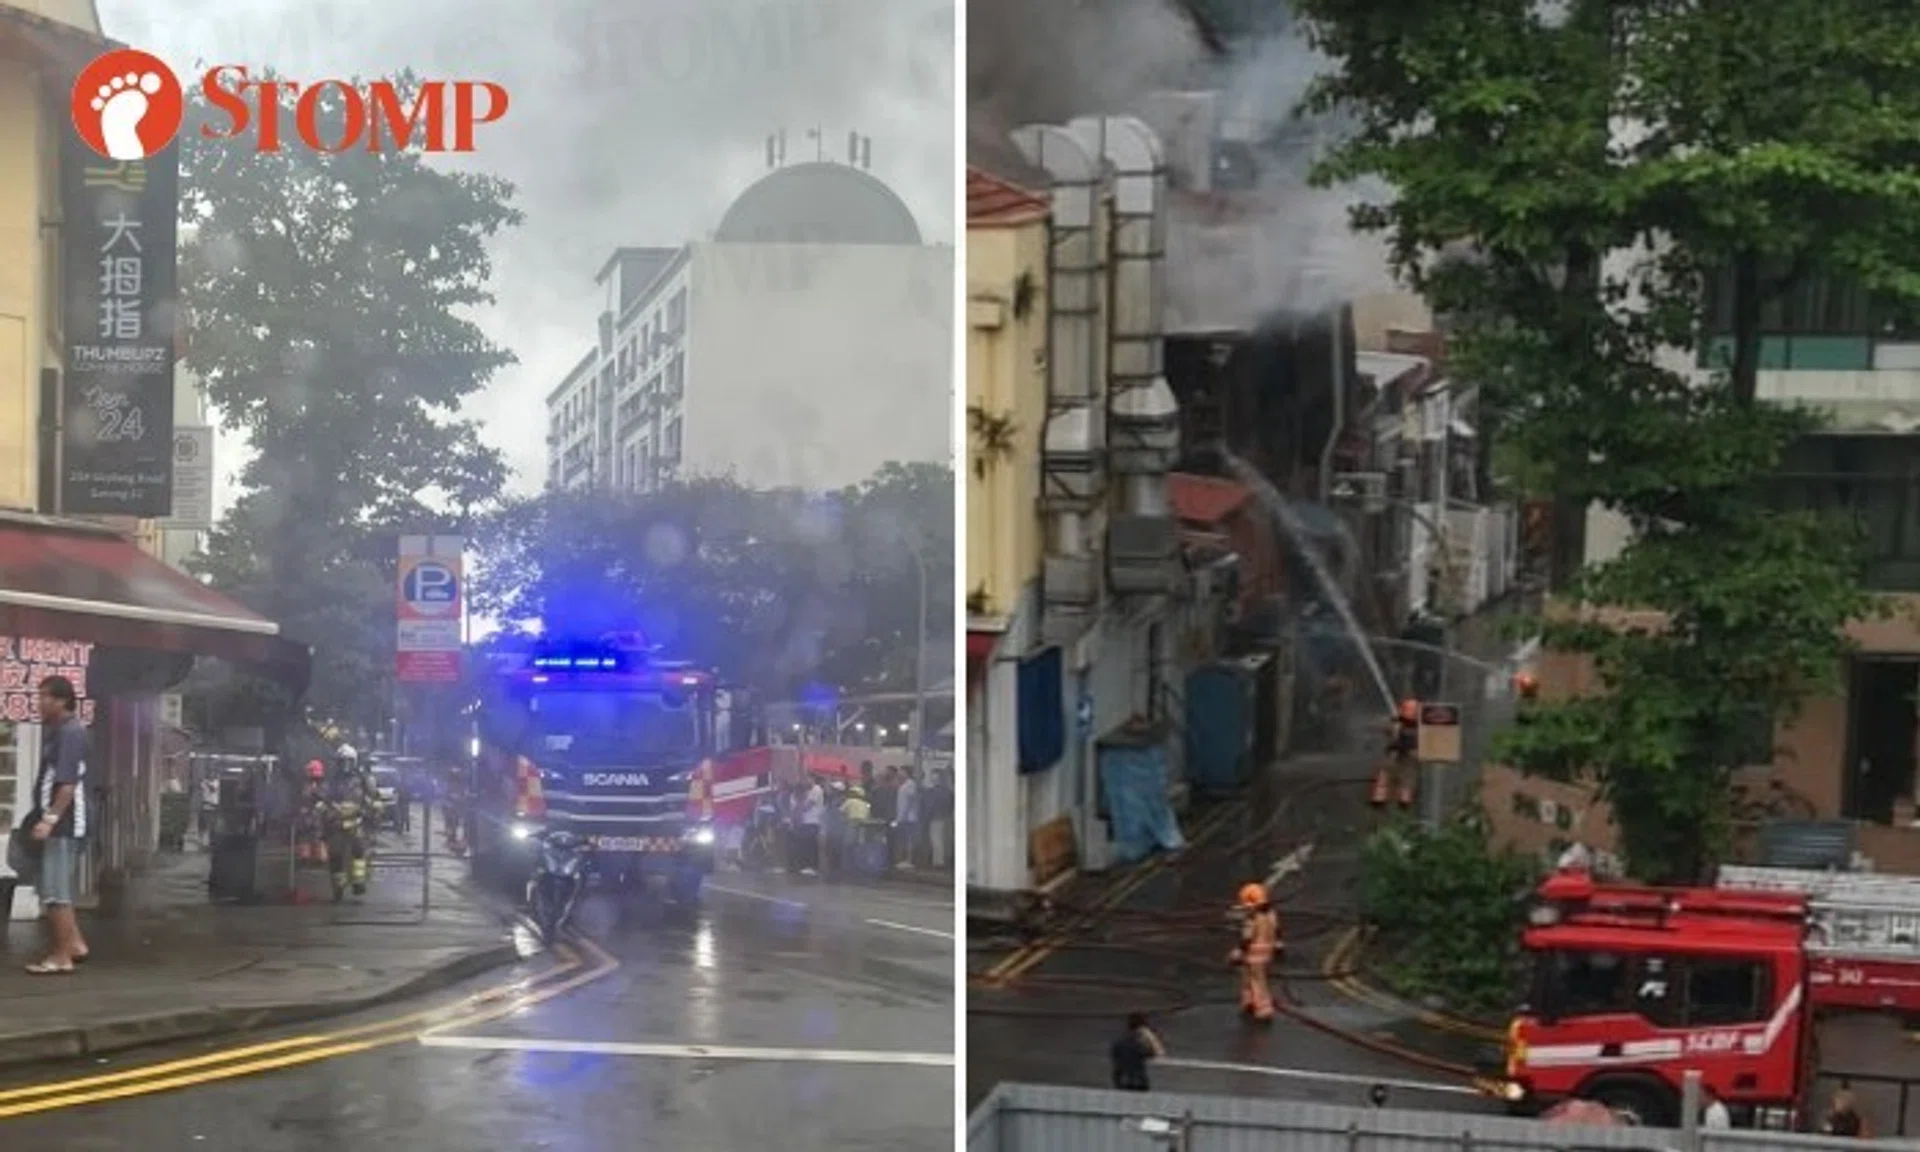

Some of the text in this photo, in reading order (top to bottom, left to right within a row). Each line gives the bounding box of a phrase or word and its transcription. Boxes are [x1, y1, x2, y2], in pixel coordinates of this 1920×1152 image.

[72, 345, 167, 361] THUMBUPZ
[97, 405, 146, 441] 24
[583, 771, 650, 787] SCANIA
